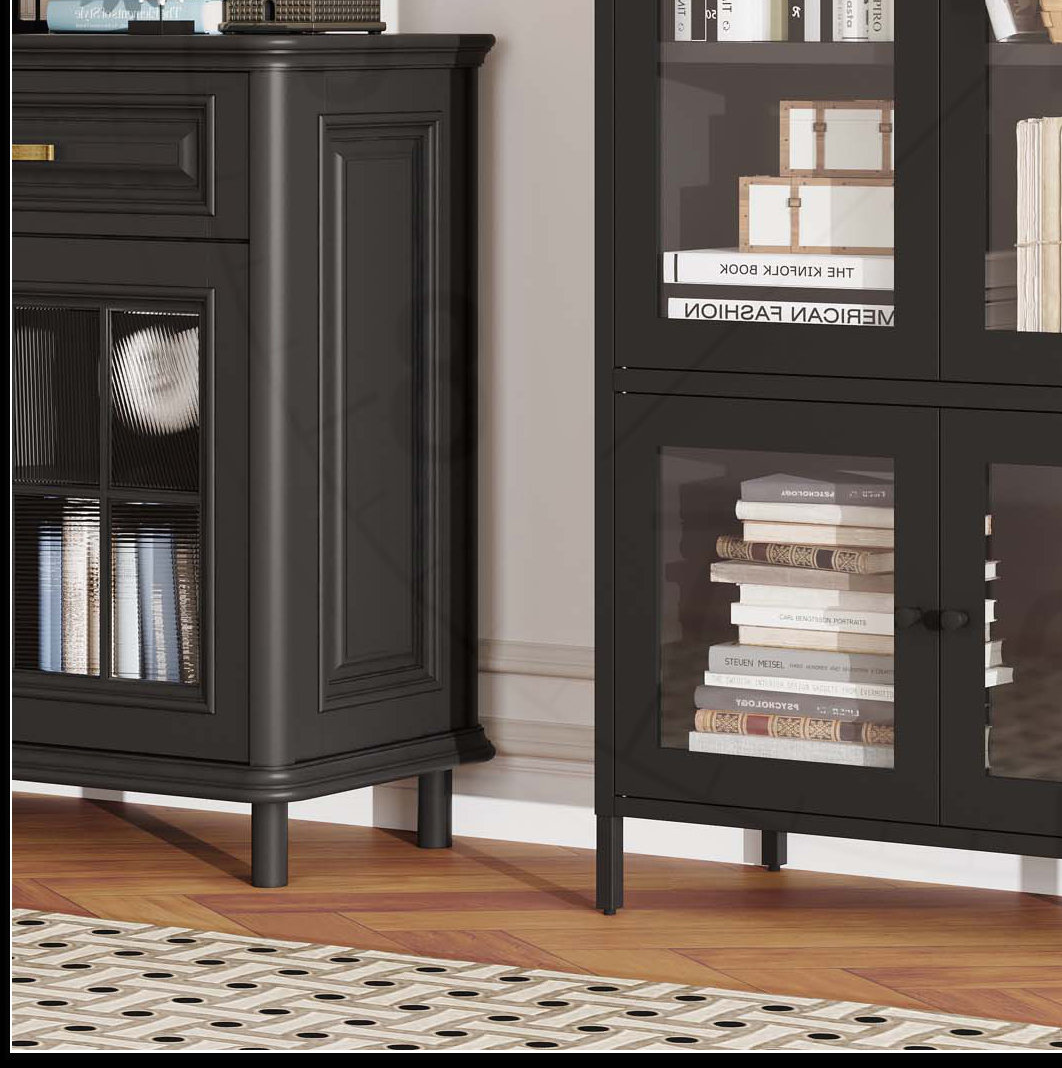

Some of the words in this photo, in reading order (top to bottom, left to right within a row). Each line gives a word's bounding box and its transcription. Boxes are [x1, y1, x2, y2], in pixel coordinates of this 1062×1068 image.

[779, 615, 795, 623] CARL
[724, 657, 754, 669] STEVEN
[757, 659, 785, 670] MEISEL
